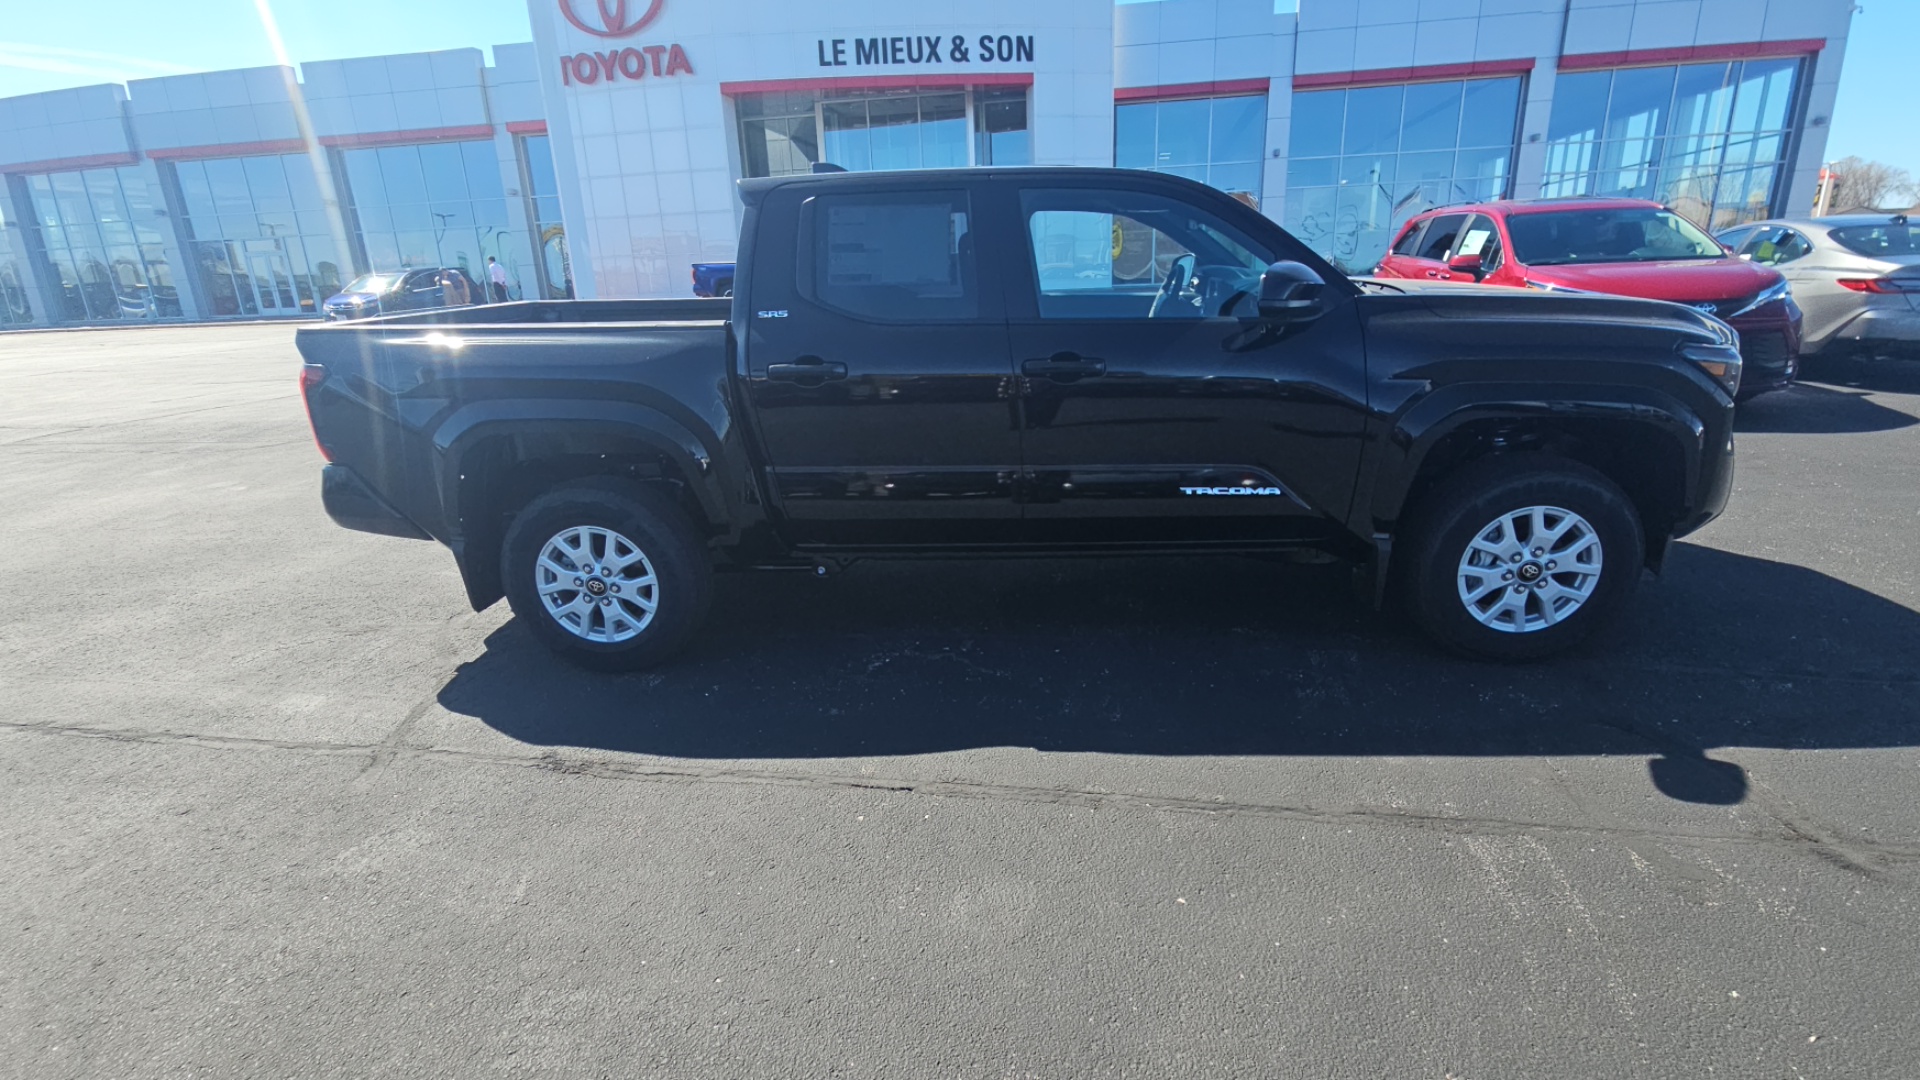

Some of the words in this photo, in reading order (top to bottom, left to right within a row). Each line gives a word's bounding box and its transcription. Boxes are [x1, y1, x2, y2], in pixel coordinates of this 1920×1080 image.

[817, 38, 847, 67] LE
[854, 35, 943, 66] MIEUX
[949, 34, 971, 63] &
[978, 34, 1034, 63] SON
[559, 43, 694, 87] TOYOTA
[757, 309, 789, 319] SR5
[1179, 486, 1282, 496] TACOMA
